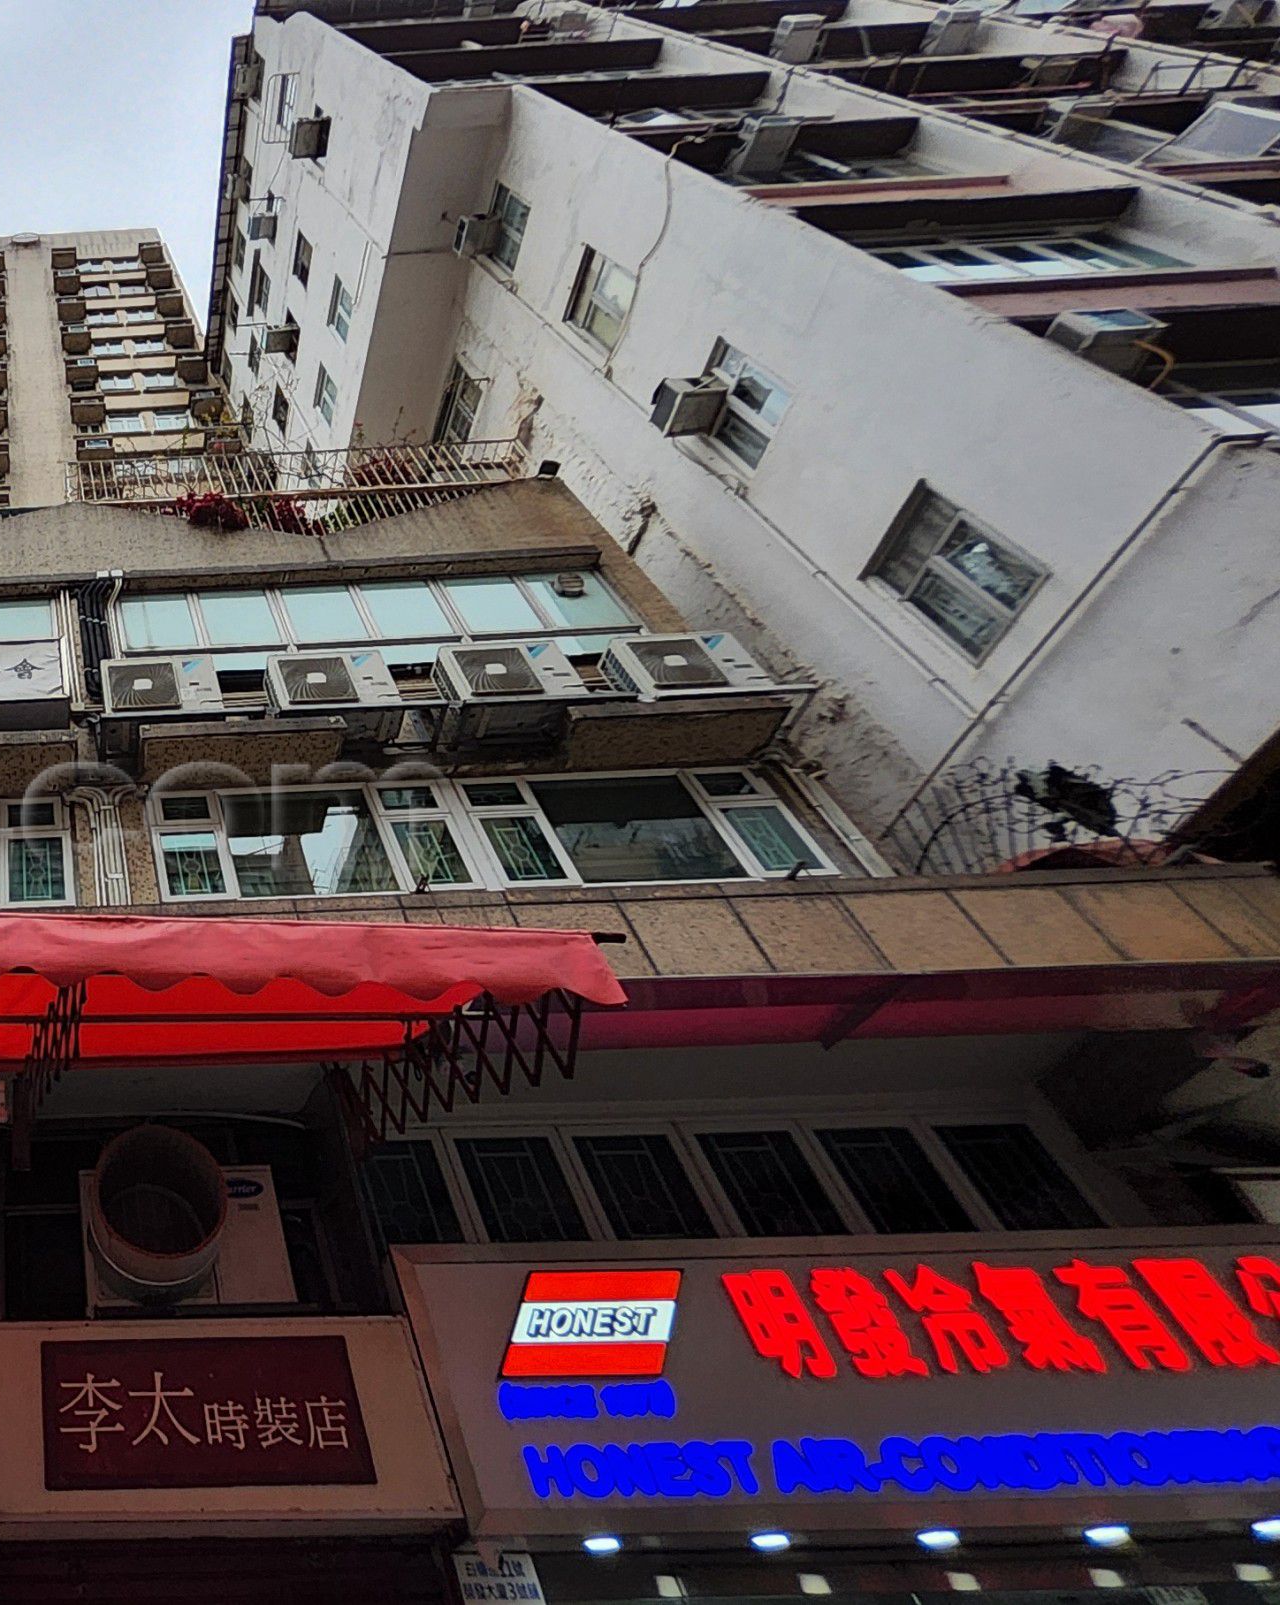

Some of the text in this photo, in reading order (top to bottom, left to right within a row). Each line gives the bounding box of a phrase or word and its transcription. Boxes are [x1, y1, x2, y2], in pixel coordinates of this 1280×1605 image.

[526, 1306, 658, 1338] HONEST
[58, 1371, 350, 1453] 李太時裝店
[521, 1439, 761, 1499] HONEST
